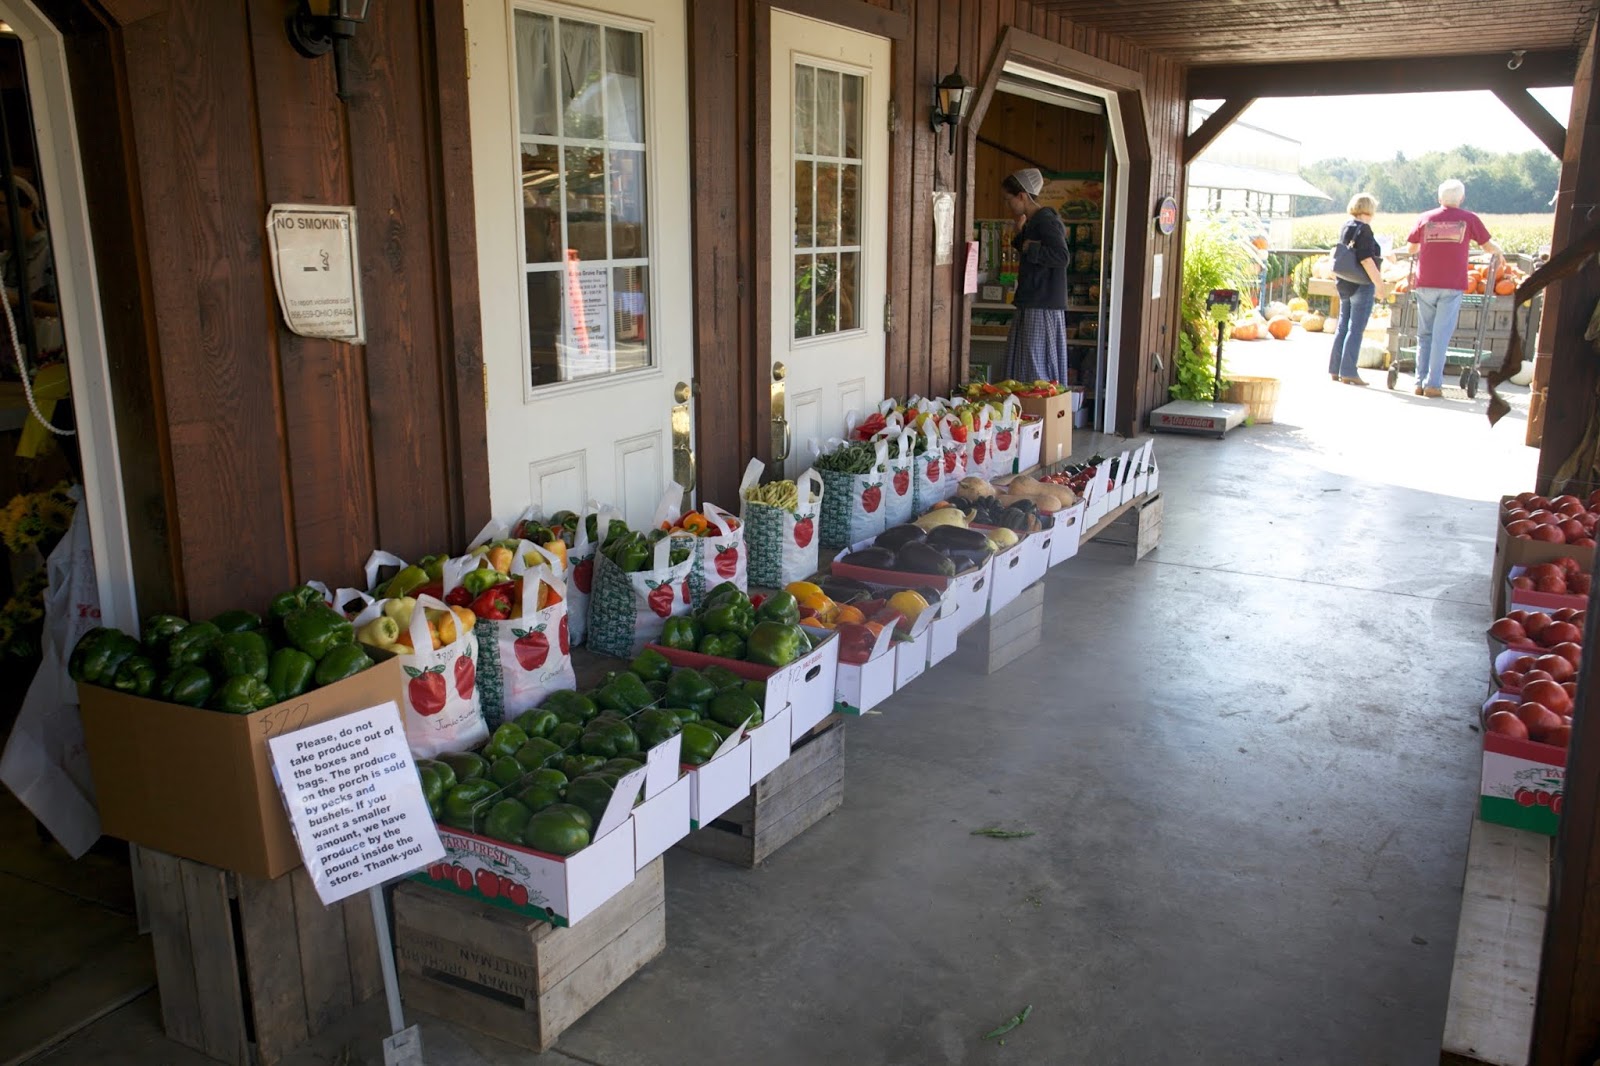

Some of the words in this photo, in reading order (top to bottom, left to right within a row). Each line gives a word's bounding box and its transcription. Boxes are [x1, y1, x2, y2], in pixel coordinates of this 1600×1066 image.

[277, 218, 294, 229] NO
[290, 754, 314, 766] take
[318, 739, 361, 759] produce
[364, 731, 381, 742] out
[384, 726, 394, 735] of
[296, 734, 337, 751] Please,
[340, 729, 352, 737] do
[356, 721, 373, 732] not
[294, 768, 312, 778] the
[314, 756, 347, 771] boxes
[350, 748, 369, 760] and
[297, 778, 327, 791] bags.
[330, 768, 350, 779] The
[354, 752, 396, 773] produce
[302, 794, 315, 802] on
[318, 786, 335, 797] the
[339, 774, 369, 791] porch
[384, 760, 406, 774] sold
[305, 806, 318, 815] by
[321, 793, 352, 811] pecks
[356, 784, 375, 797] and
[309, 808, 354, 827] bushels.
[356, 801, 364, 810] If
[368, 794, 387, 807] you
[313, 823, 340, 839] want
[352, 805, 391, 825] smaller
[316, 830, 361, 852] amount,
[363, 823, 379, 833] we
[382, 812, 406, 826] have
[321, 841, 365, 865] produce
[368, 835, 381, 844] by
[384, 828, 400, 838] the
[325, 856, 359, 877] pound
[362, 842, 394, 860] inside
[396, 836, 413, 846] the
[474, 842, 509, 866] FRESH
[330, 870, 363, 887] store.
[364, 844, 422, 872] Thank-you!
